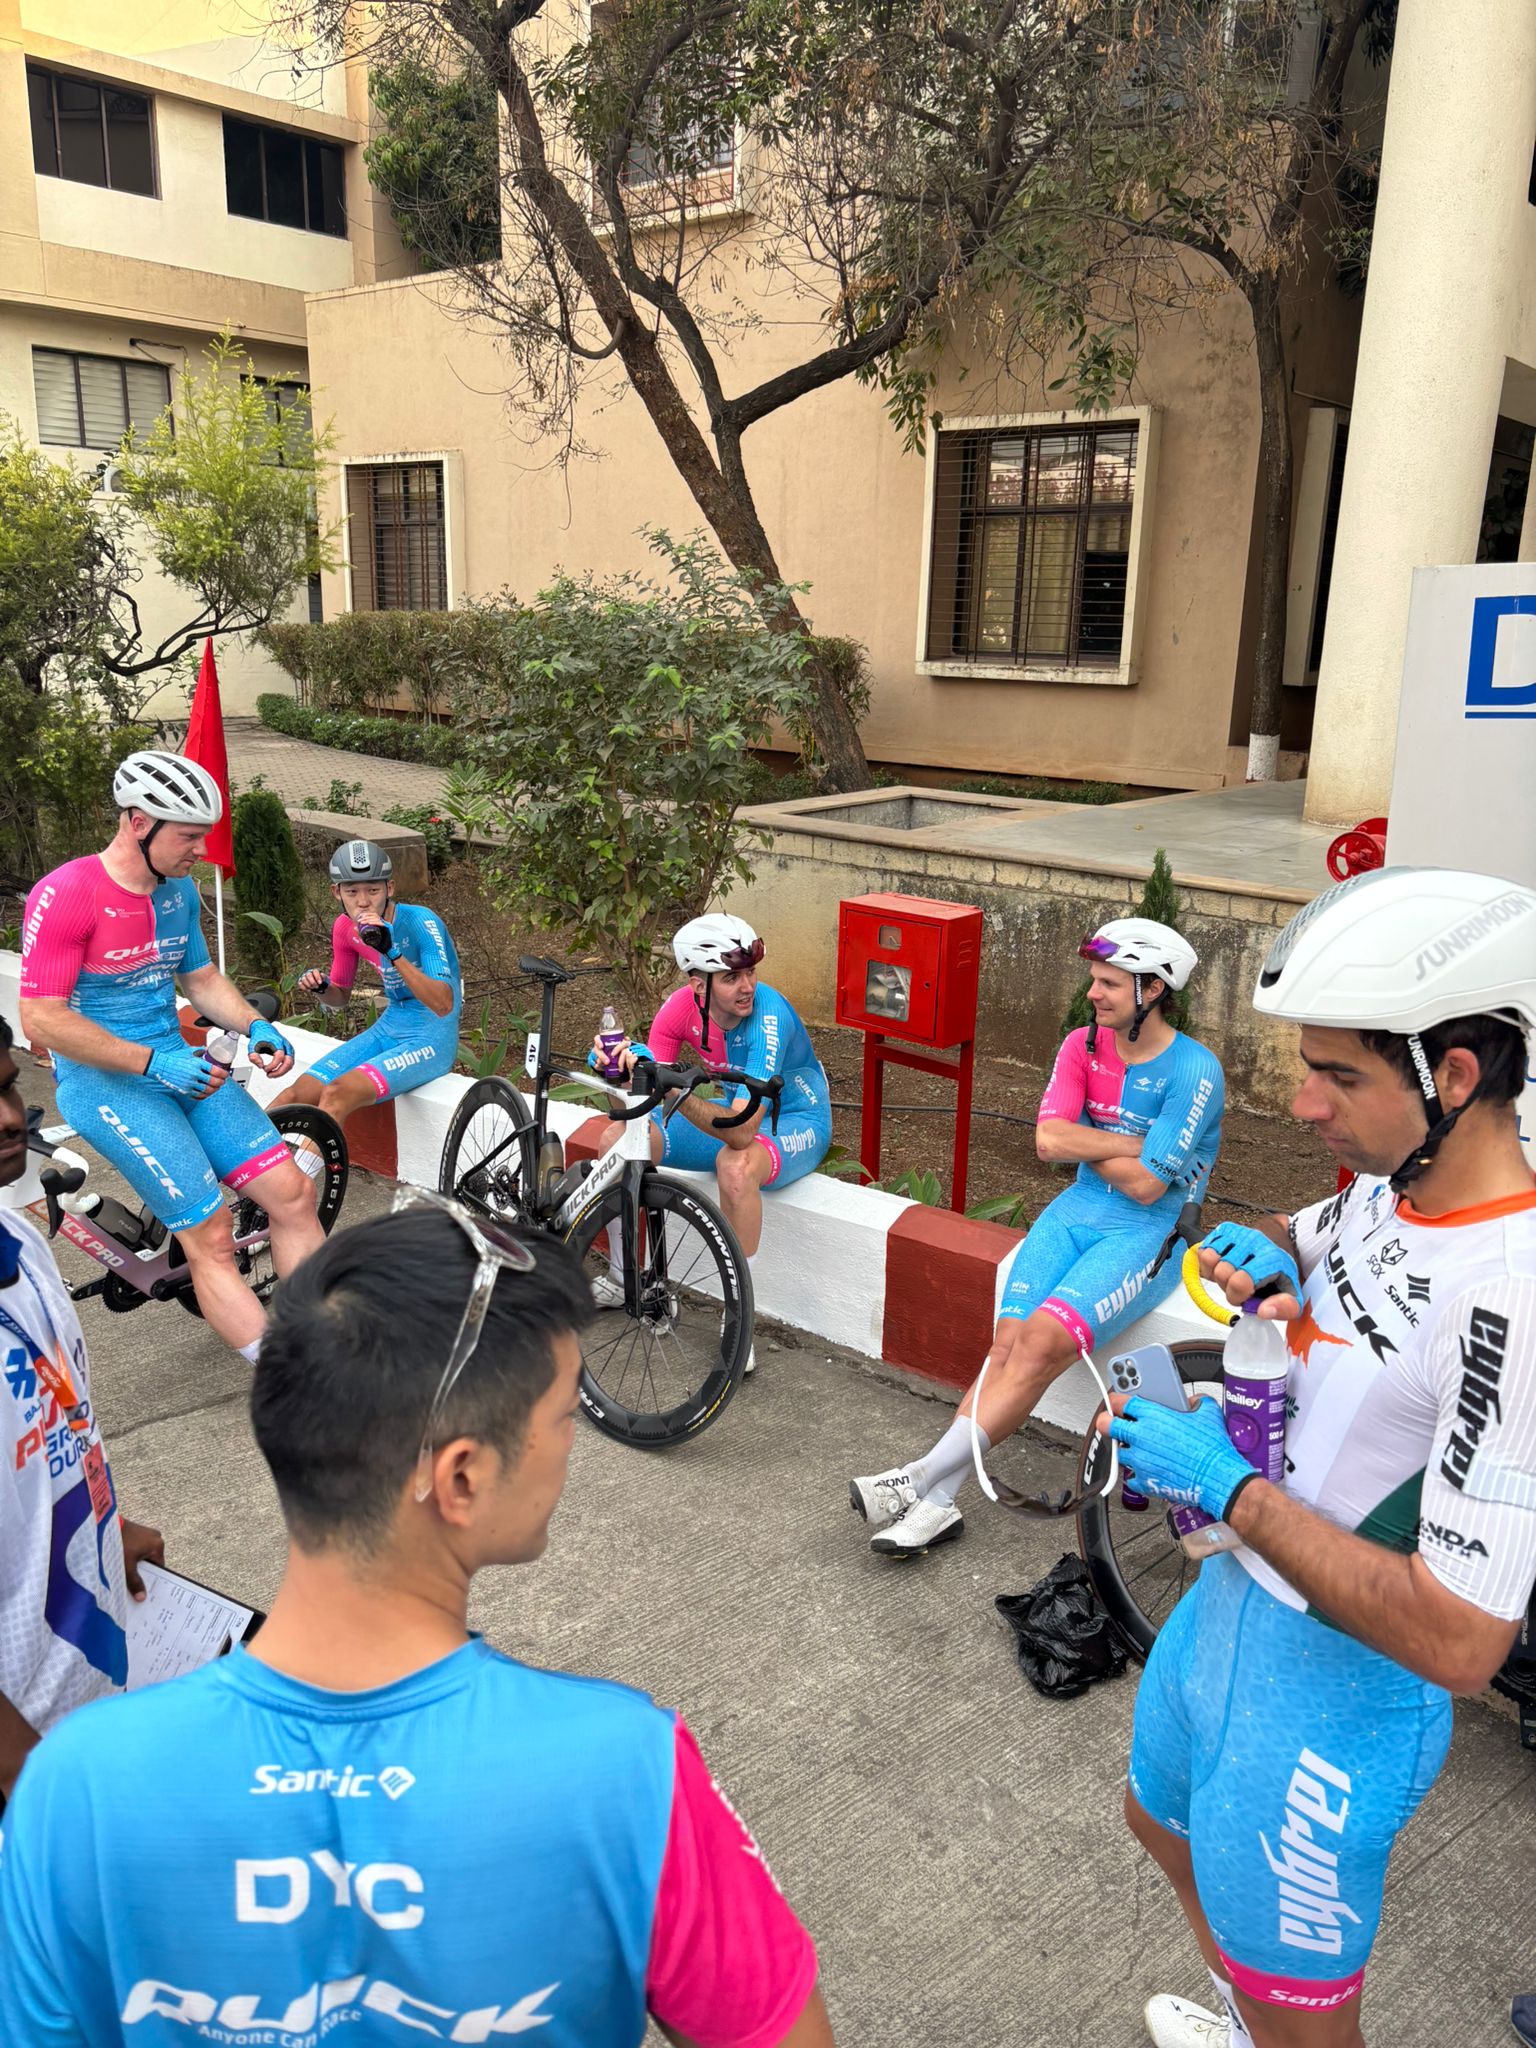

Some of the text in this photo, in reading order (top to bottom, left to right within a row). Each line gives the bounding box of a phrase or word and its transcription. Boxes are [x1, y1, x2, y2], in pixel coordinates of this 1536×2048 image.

[1416, 893, 1532, 981] SUNRIMOON
[98, 1105, 185, 1200] QUICK
[590, 1153, 618, 1190] PRO
[86, 1239, 125, 1267] PRO
[1328, 1234, 1400, 1367] UICK
[1384, 1284, 1420, 1329] Santic
[1226, 1389, 1264, 1410] Bailley
[250, 1764, 375, 1798] Santic
[235, 1849, 425, 1930] DYC
[199, 2024, 276, 2046] Anyone
